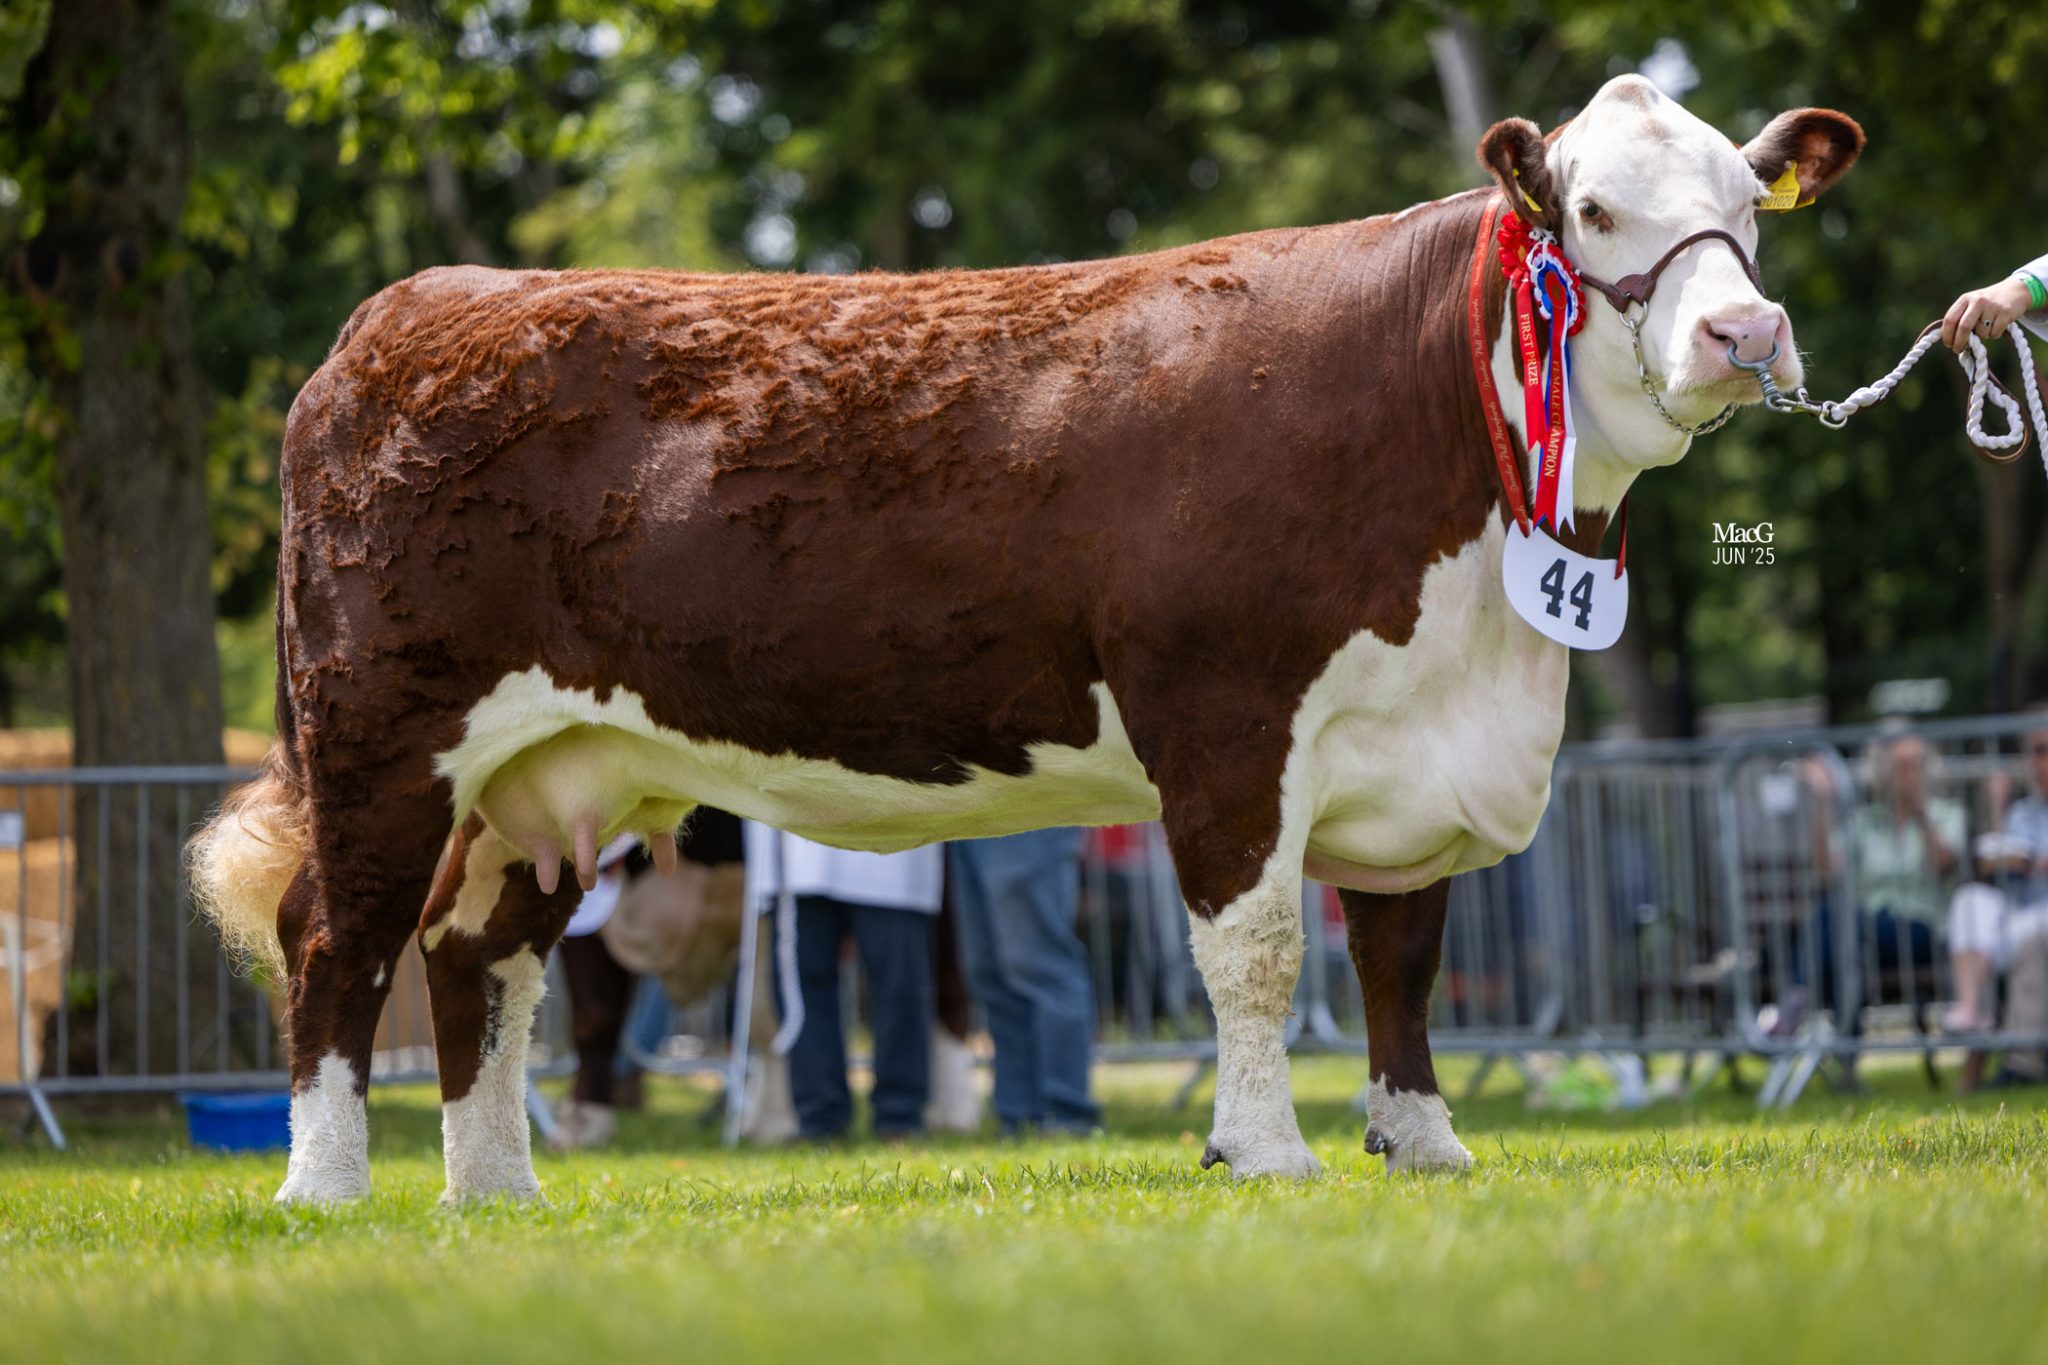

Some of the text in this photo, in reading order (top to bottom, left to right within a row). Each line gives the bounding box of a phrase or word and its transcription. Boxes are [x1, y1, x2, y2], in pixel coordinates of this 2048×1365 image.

[1521, 313, 1539, 387] FIRST PRIZE
[1544, 361, 1561, 477] FEMALE CHAMPION
[1540, 558, 1595, 632] 44
